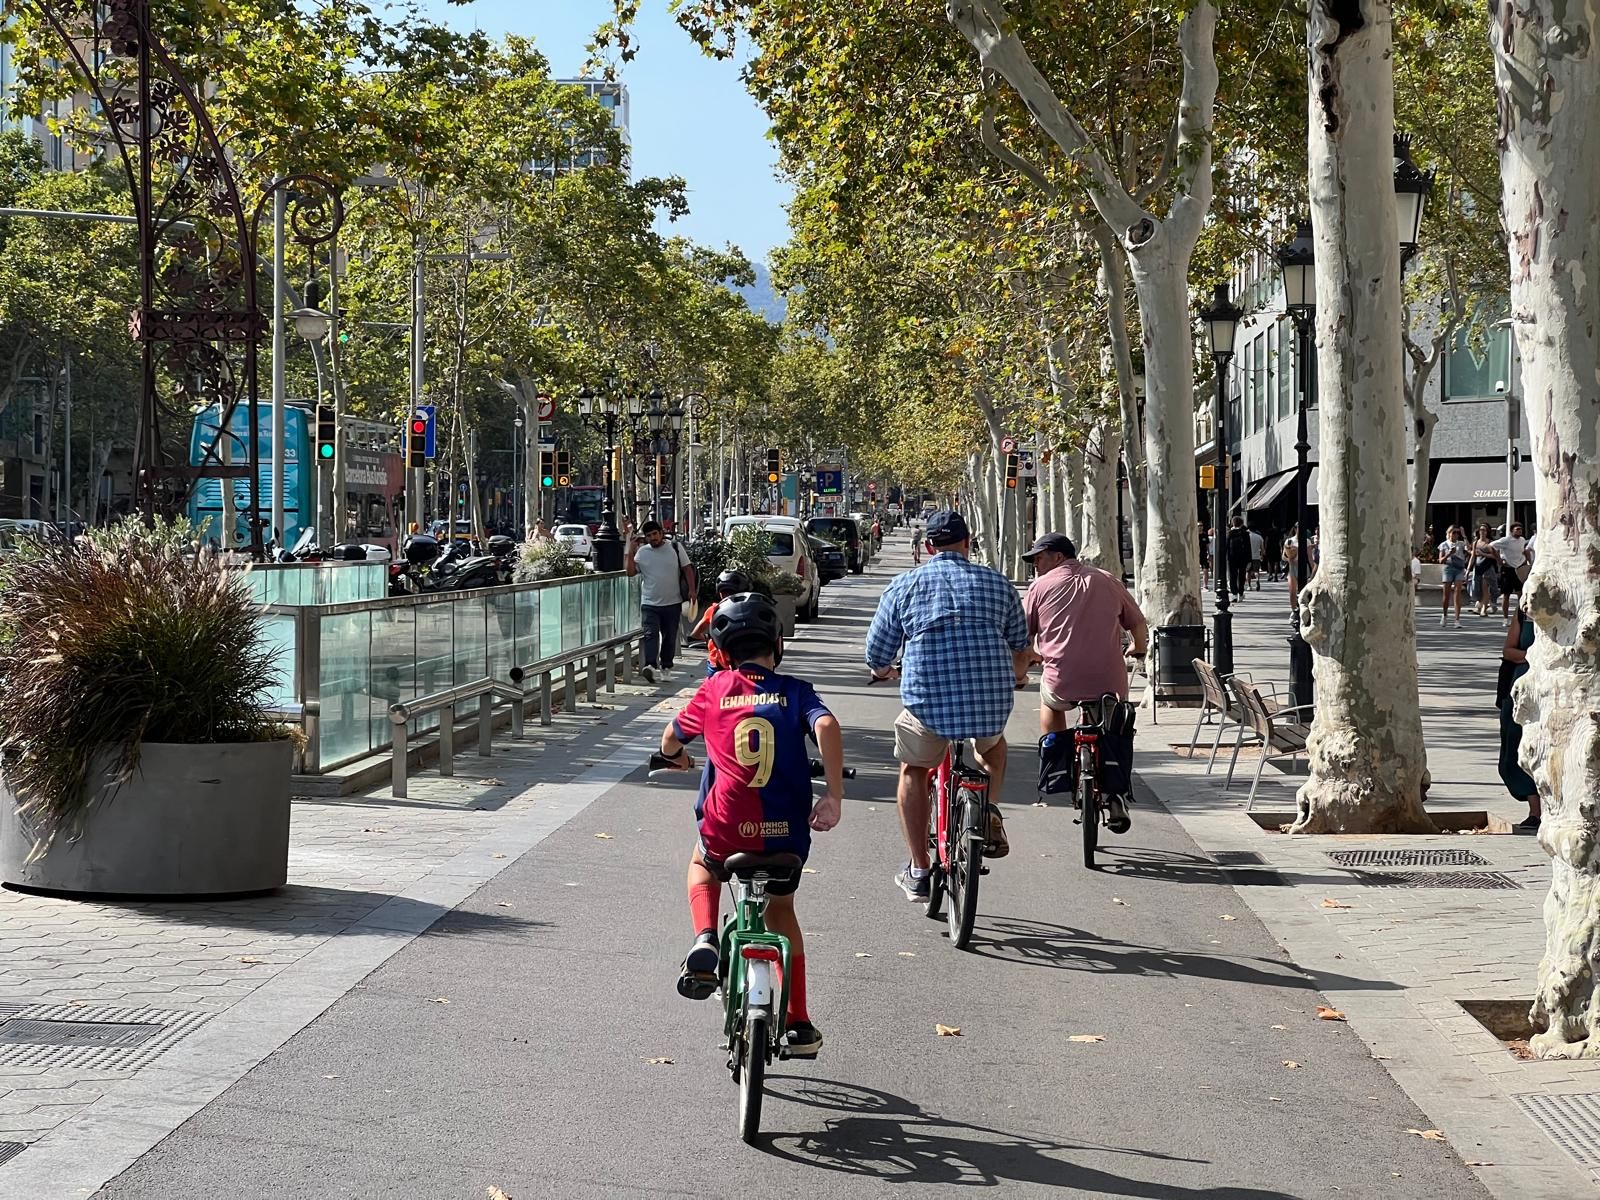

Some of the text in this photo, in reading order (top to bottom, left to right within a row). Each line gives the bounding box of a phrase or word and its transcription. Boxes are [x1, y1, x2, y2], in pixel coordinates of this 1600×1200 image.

[284, 448, 296, 457] 33
[734, 716, 775, 788] 9
[759, 821, 789, 829] UNHCR
[759, 827, 789, 835] ACNUR
